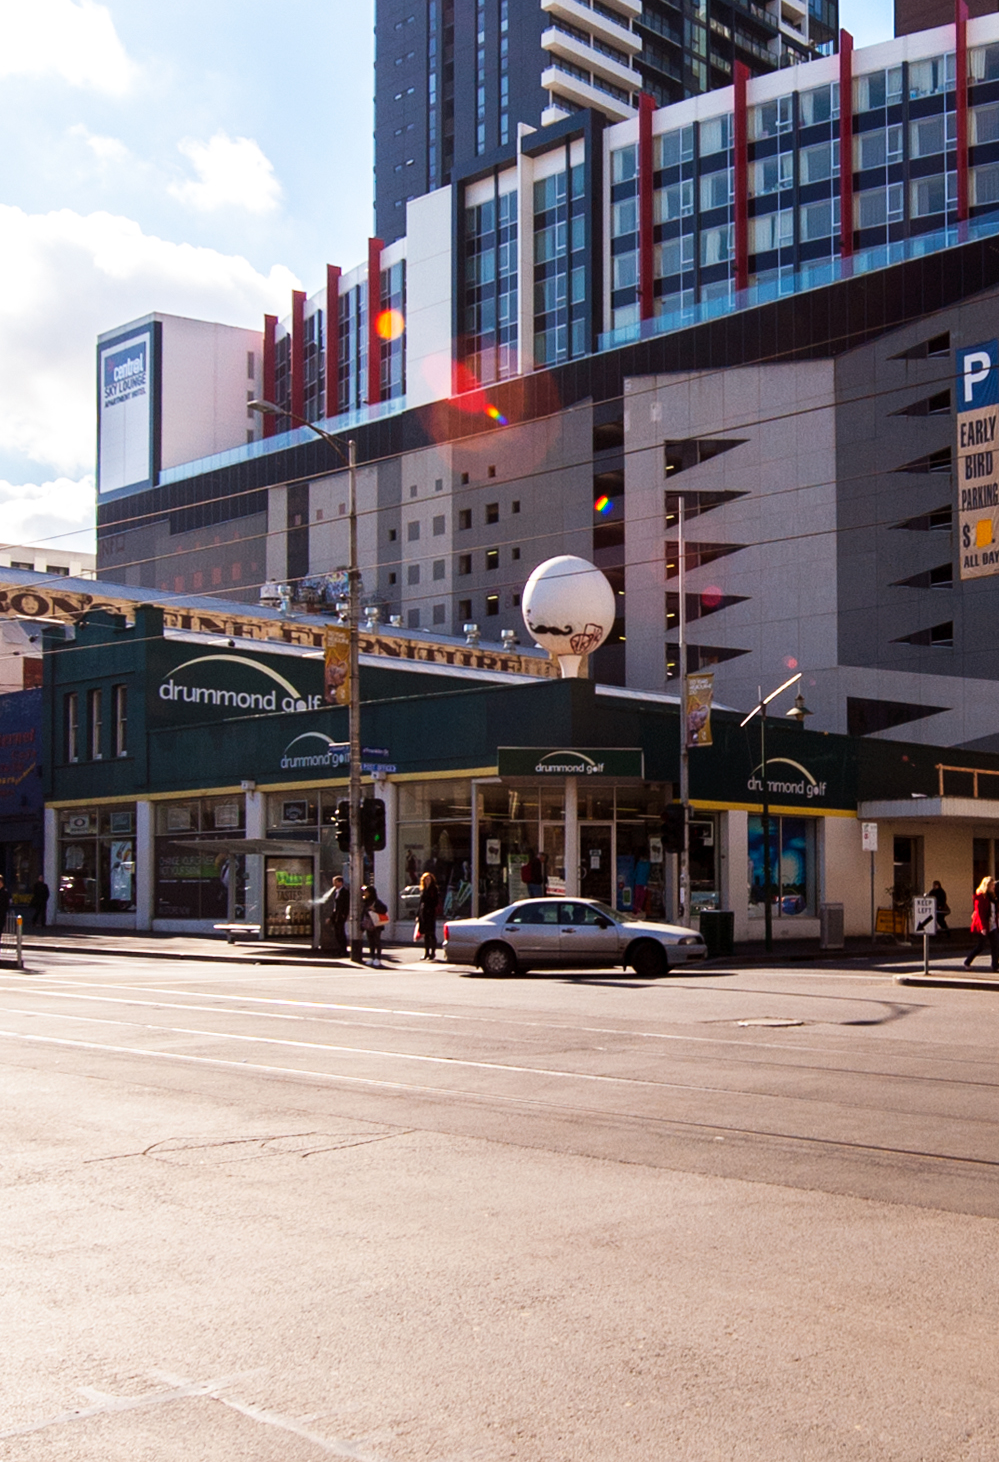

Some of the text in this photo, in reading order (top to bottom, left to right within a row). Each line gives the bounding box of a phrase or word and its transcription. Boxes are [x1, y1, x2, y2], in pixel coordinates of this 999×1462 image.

[104, 372, 146, 399] SKY LOUNGE
[963, 351, 991, 403] P
[960, 415, 996, 448] EARLY
[965, 450, 993, 480] BIRD
[961, 482, 998, 512] PARKING
[964, 550, 999, 569] ALL DAY
[159, 679, 323, 713] drummond golf
[280, 754, 330, 769] drummond
[535, 762, 605, 775] drummond golf
[806, 781, 827, 799] golf
[917, 899, 932, 907] KEEP
